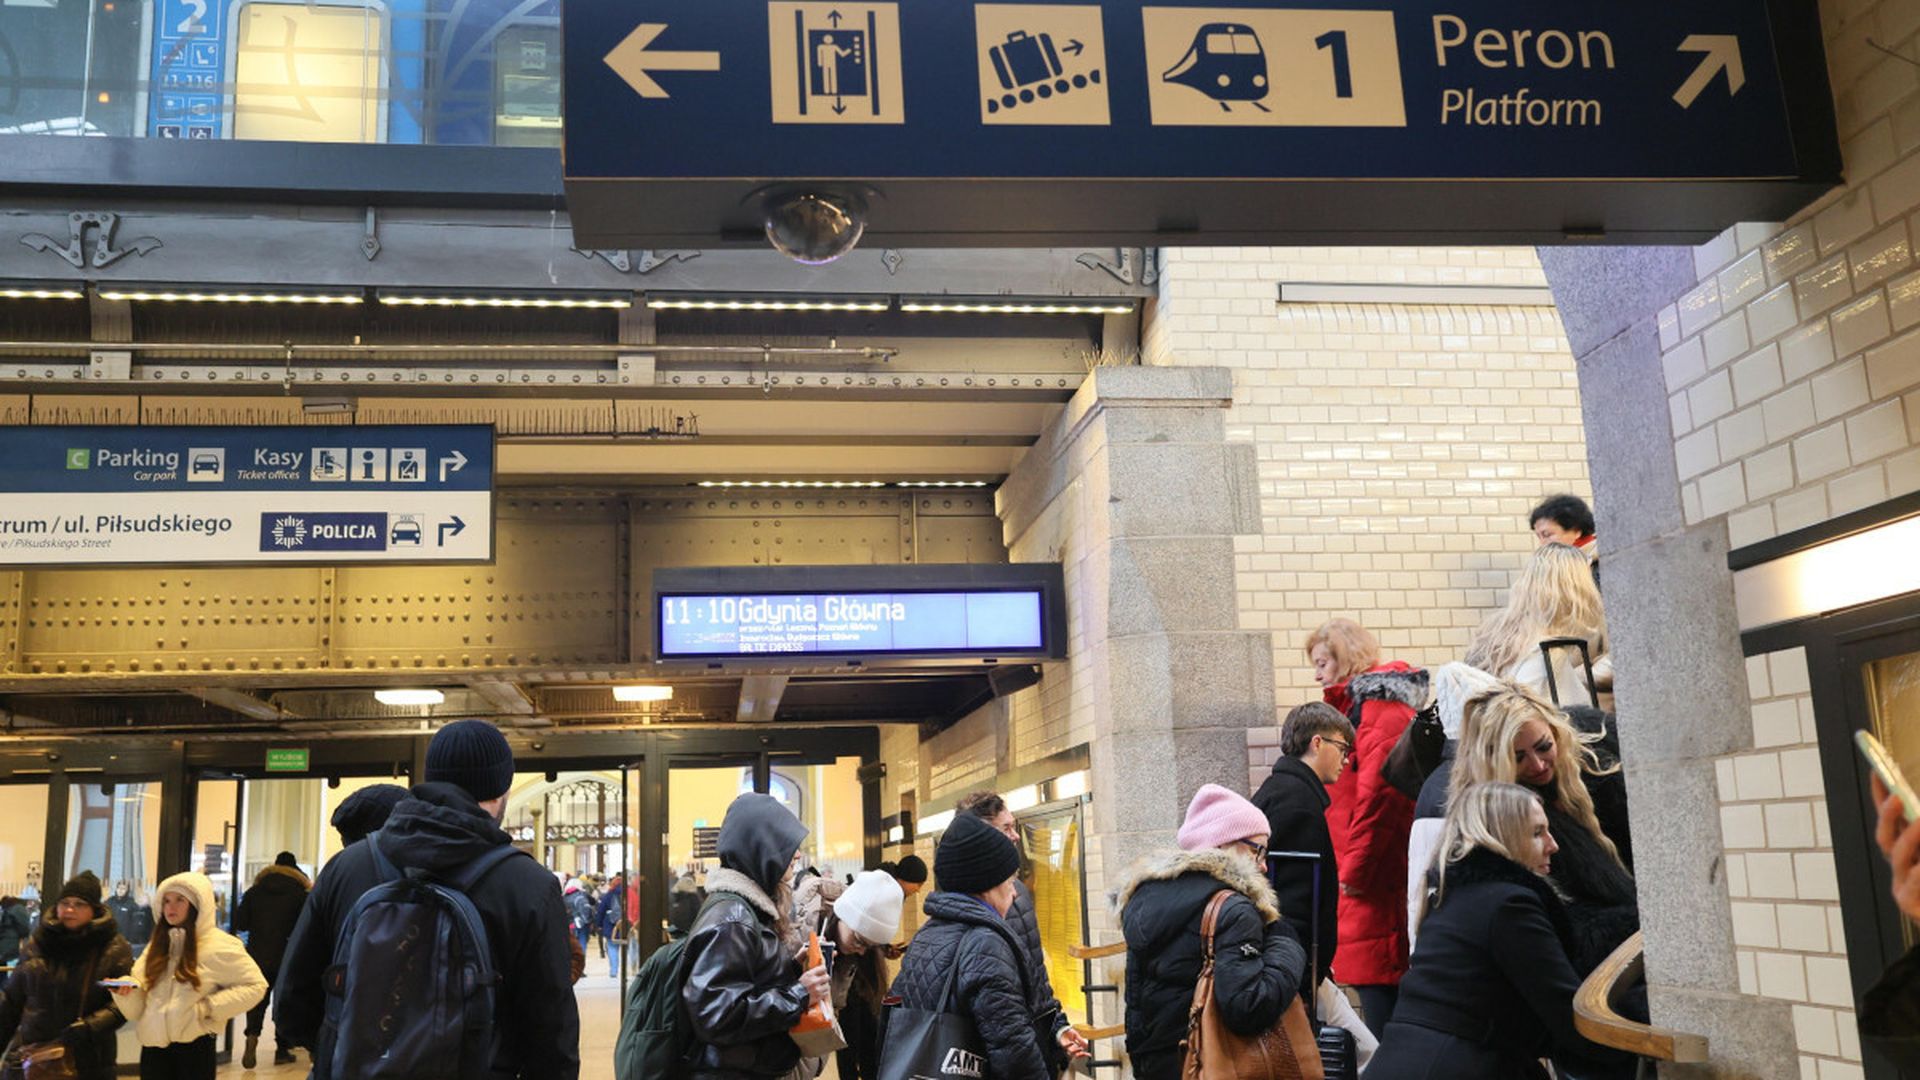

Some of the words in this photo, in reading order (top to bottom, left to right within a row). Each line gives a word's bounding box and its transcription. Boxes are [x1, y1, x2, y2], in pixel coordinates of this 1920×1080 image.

[177, 0, 208, 33] 2
[1431, 13, 1616, 69] Peron
[1314, 29, 1354, 99] 1
[1441, 88, 1602, 126] Platform
[71, 451, 85, 466] C
[97, 448, 180, 470] Parking
[254, 447, 304, 470] Kasy
[133, 471, 152, 481] Car
[153, 471, 177, 482] park
[237, 469, 267, 480] Ticket
[268, 469, 300, 480] offices
[50, 515, 61, 535] /
[64, 514, 90, 534] ul.
[96, 513, 232, 536] Piłsudskiego
[312, 525, 377, 539] POLICJA
[81, 538, 113, 548] Street
[665, 598, 736, 625] 11:10
[738, 597, 818, 625] Gdynia
[825, 596, 906, 621] Główna
